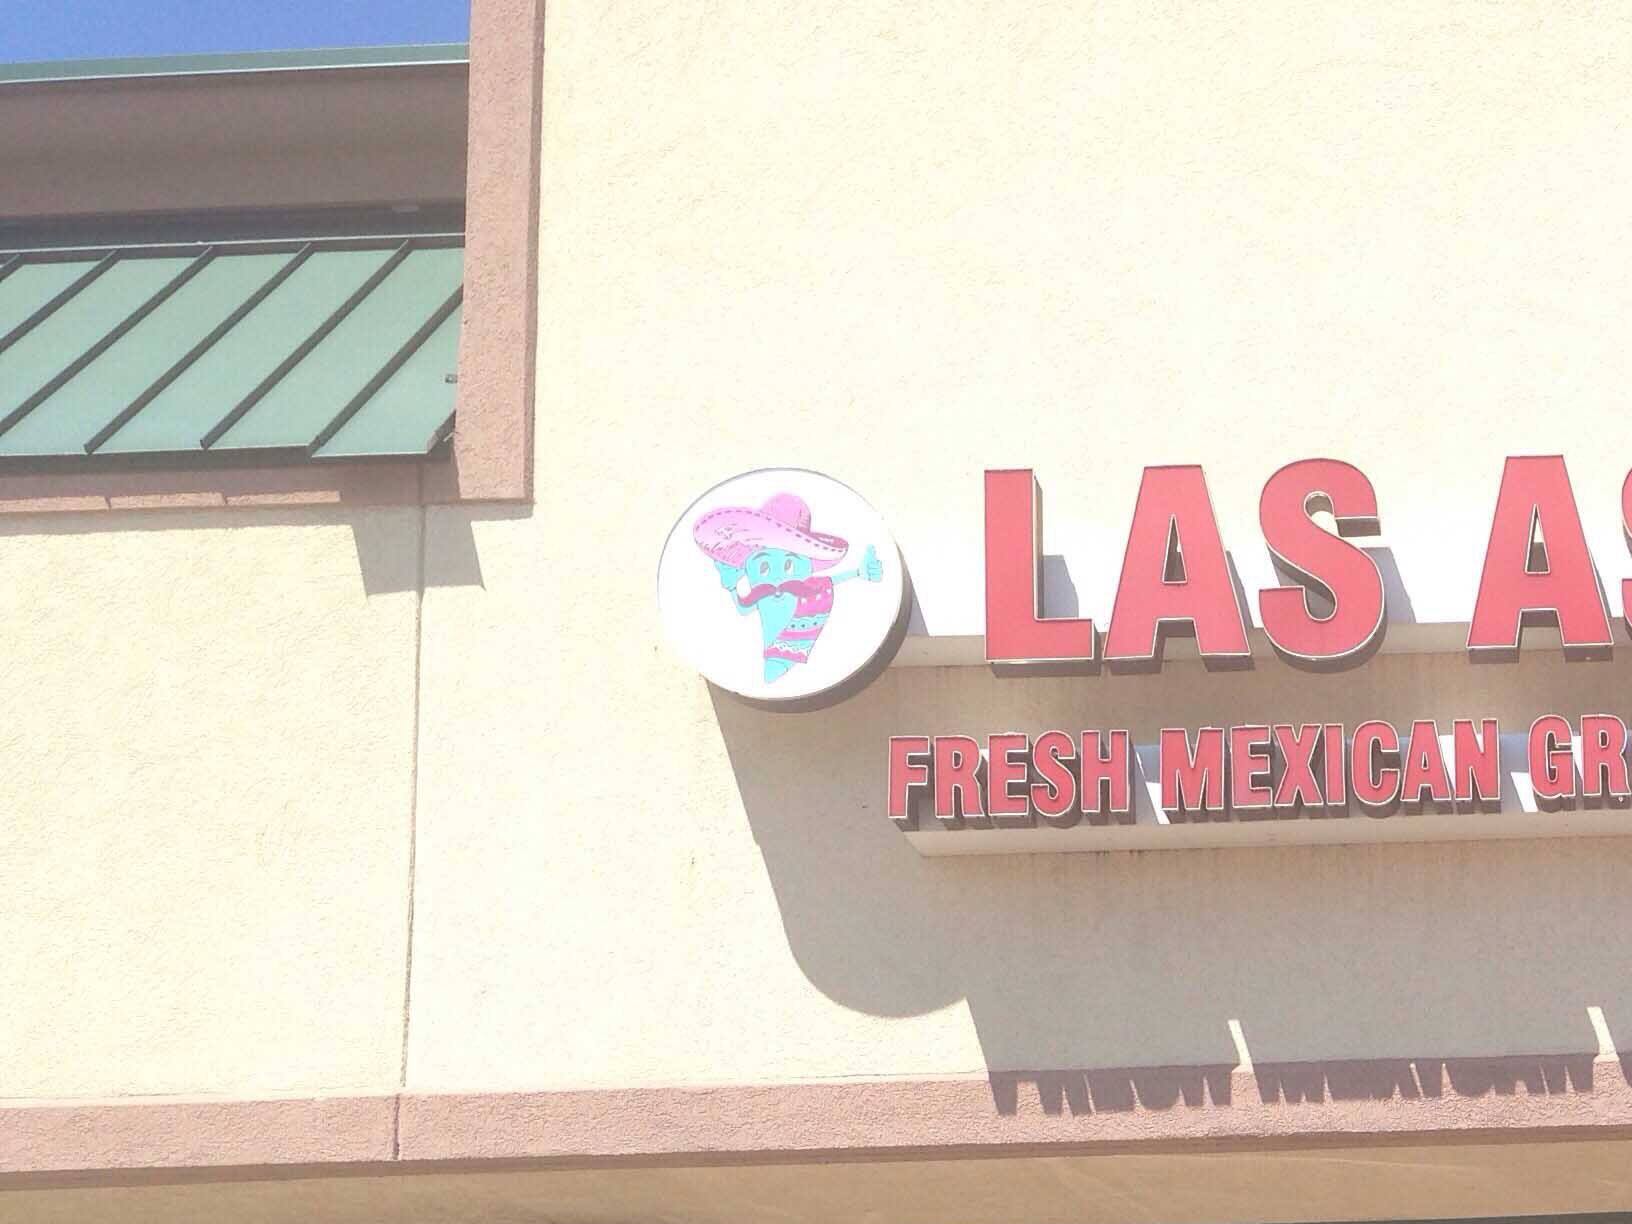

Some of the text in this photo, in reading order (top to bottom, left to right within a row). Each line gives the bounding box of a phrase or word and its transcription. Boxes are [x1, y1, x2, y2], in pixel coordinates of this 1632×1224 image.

[984, 457, 1386, 664] LAS
[887, 729, 1131, 821] FRESH
[1160, 718, 1501, 812] MEXICAN
